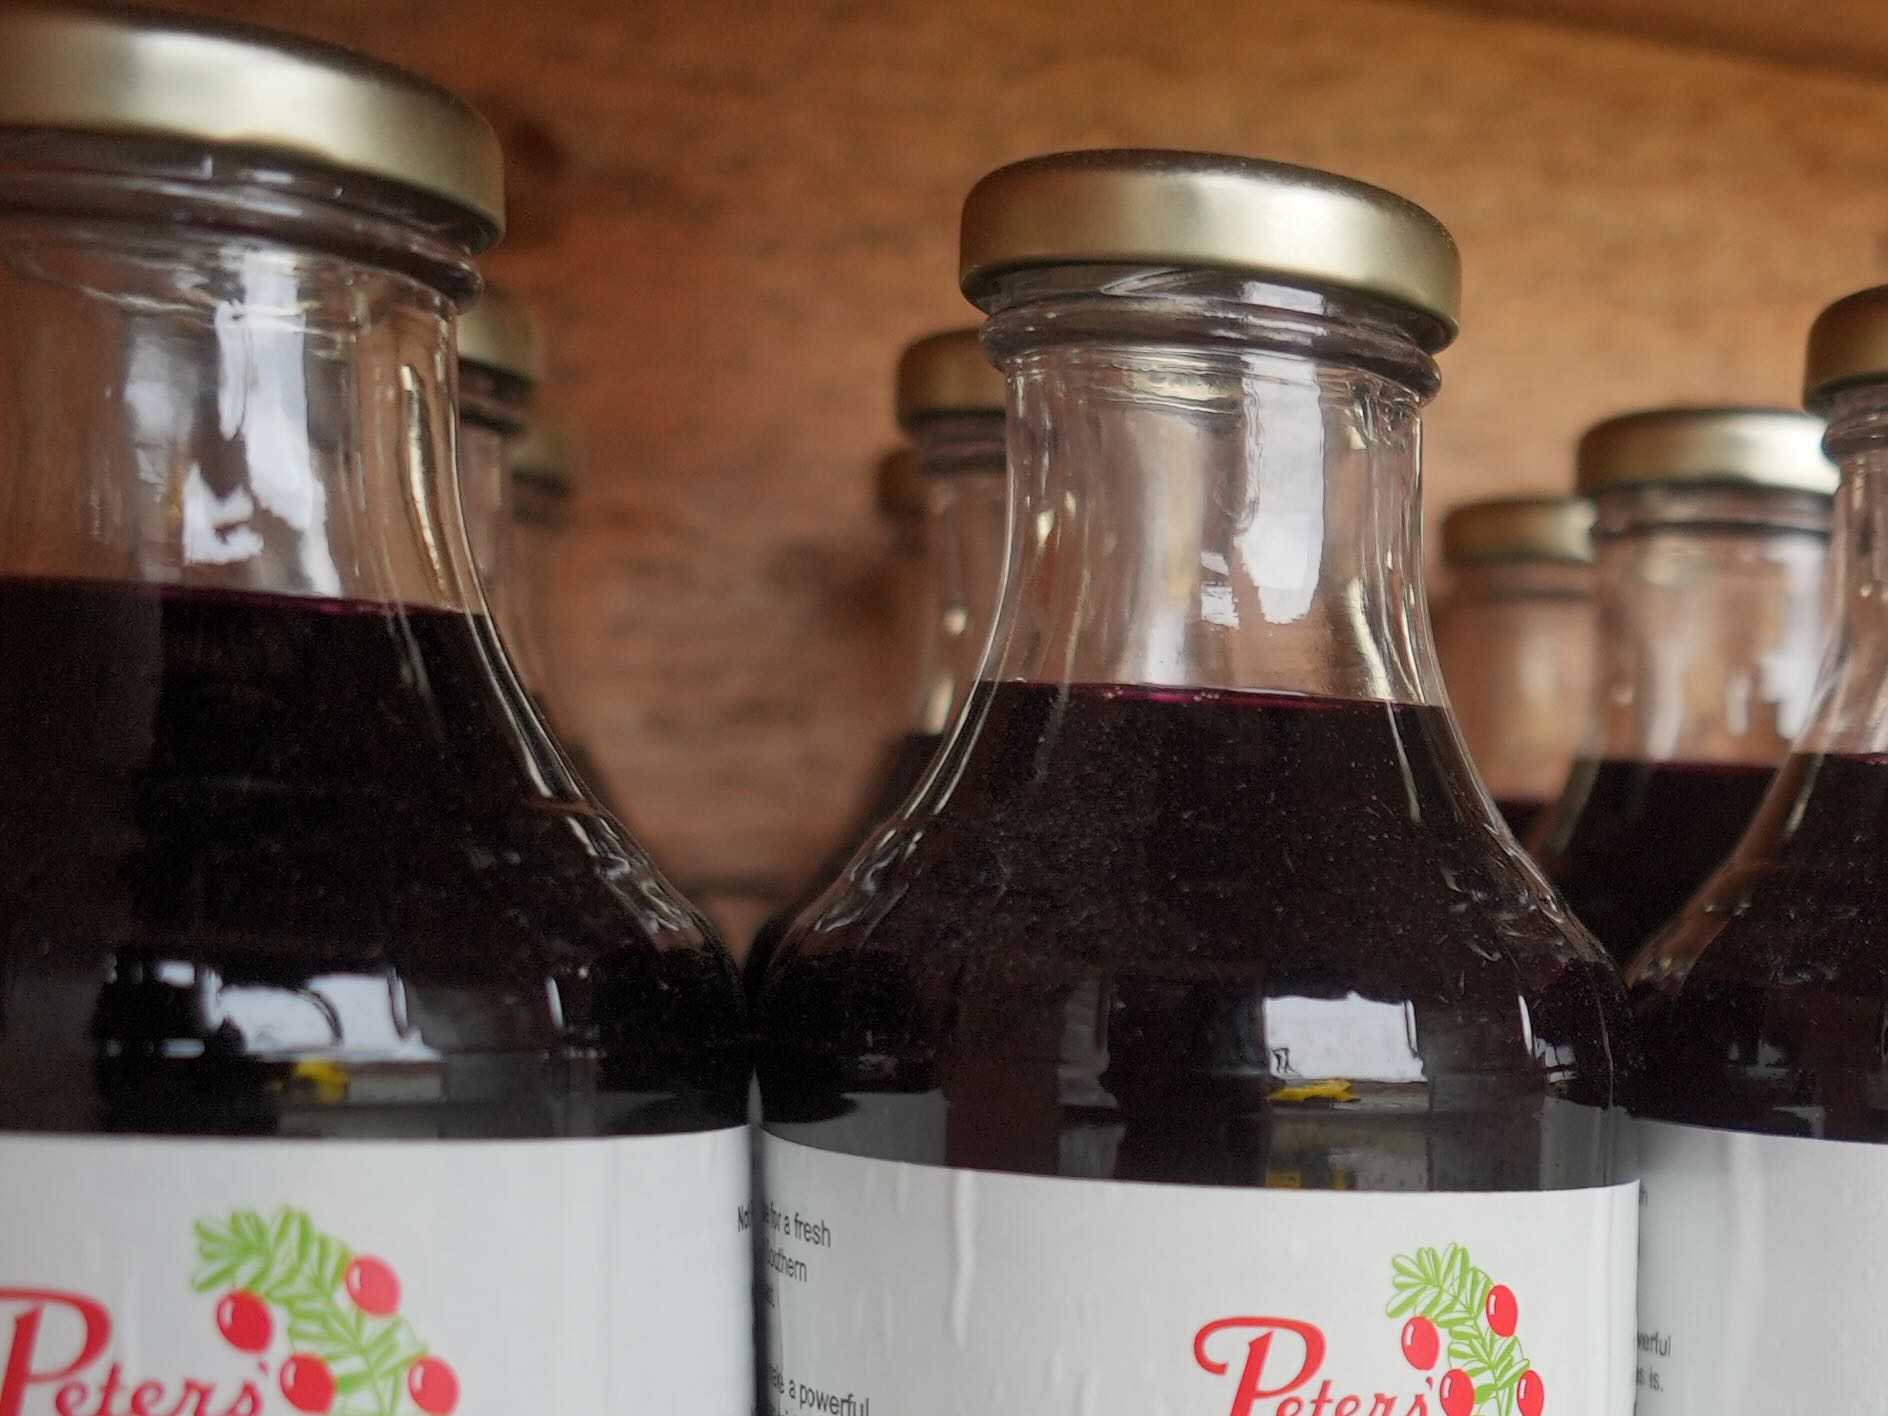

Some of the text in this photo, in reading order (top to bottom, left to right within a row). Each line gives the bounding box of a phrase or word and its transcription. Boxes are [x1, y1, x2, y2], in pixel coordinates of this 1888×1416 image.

[784, 1215, 791, 1235] a
[794, 1211, 831, 1248] fresh
[788, 1379, 796, 1400] a
